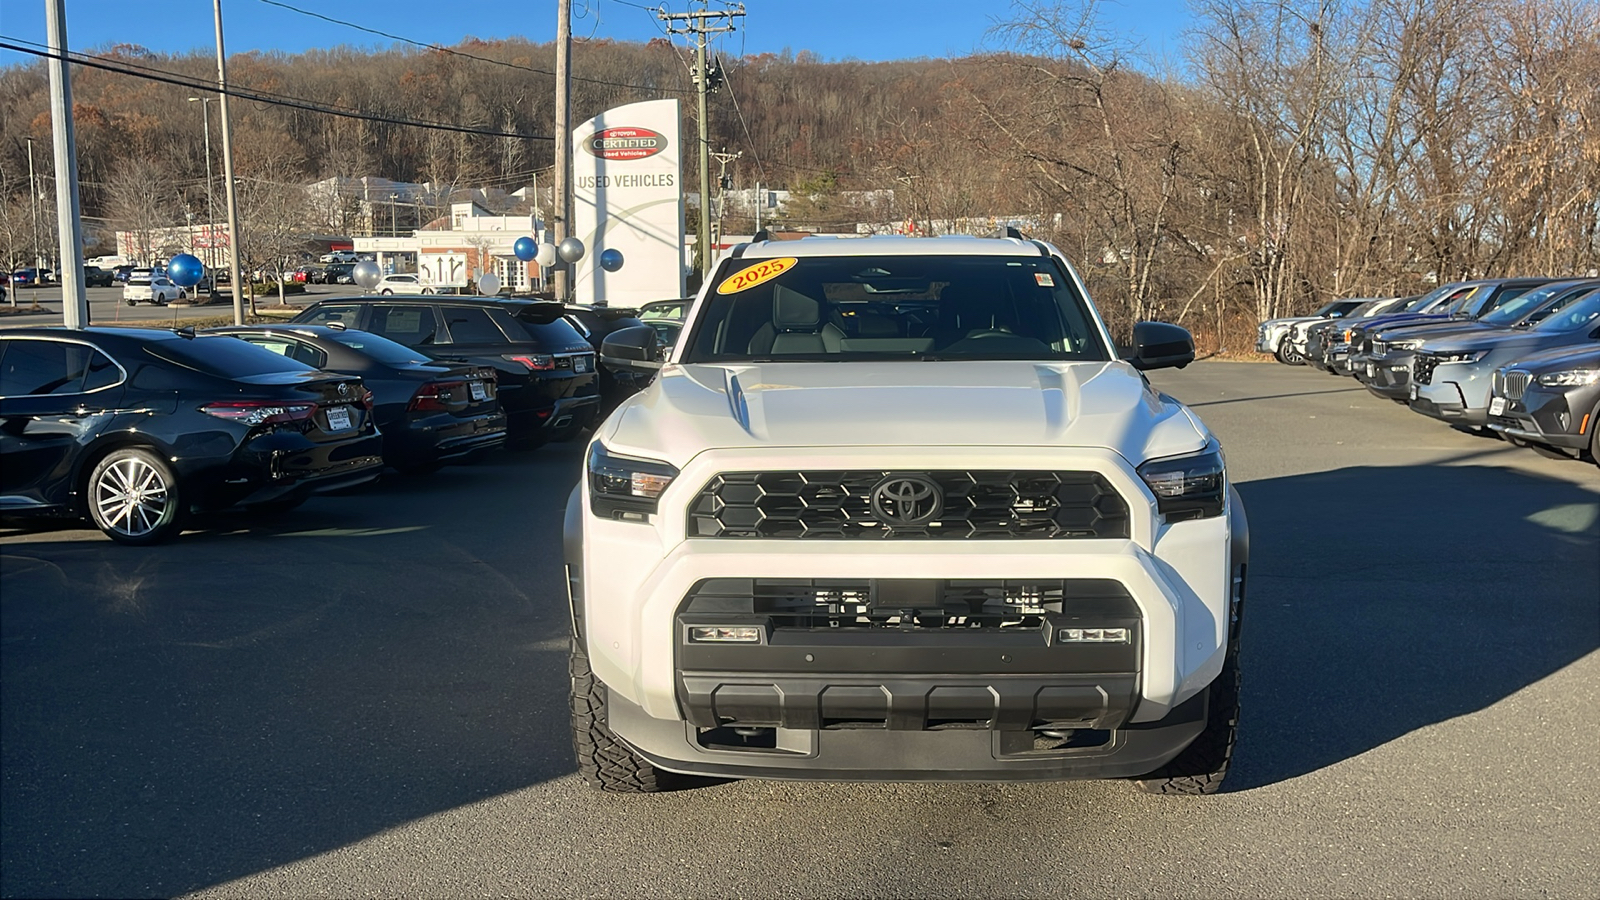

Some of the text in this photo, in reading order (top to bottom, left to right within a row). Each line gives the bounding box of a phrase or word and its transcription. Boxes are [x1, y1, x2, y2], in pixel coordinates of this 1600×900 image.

[593, 139, 657, 149] CERTIFIED
[579, 174, 674, 188] USED VEHICLES
[732, 260, 784, 289] 2025
